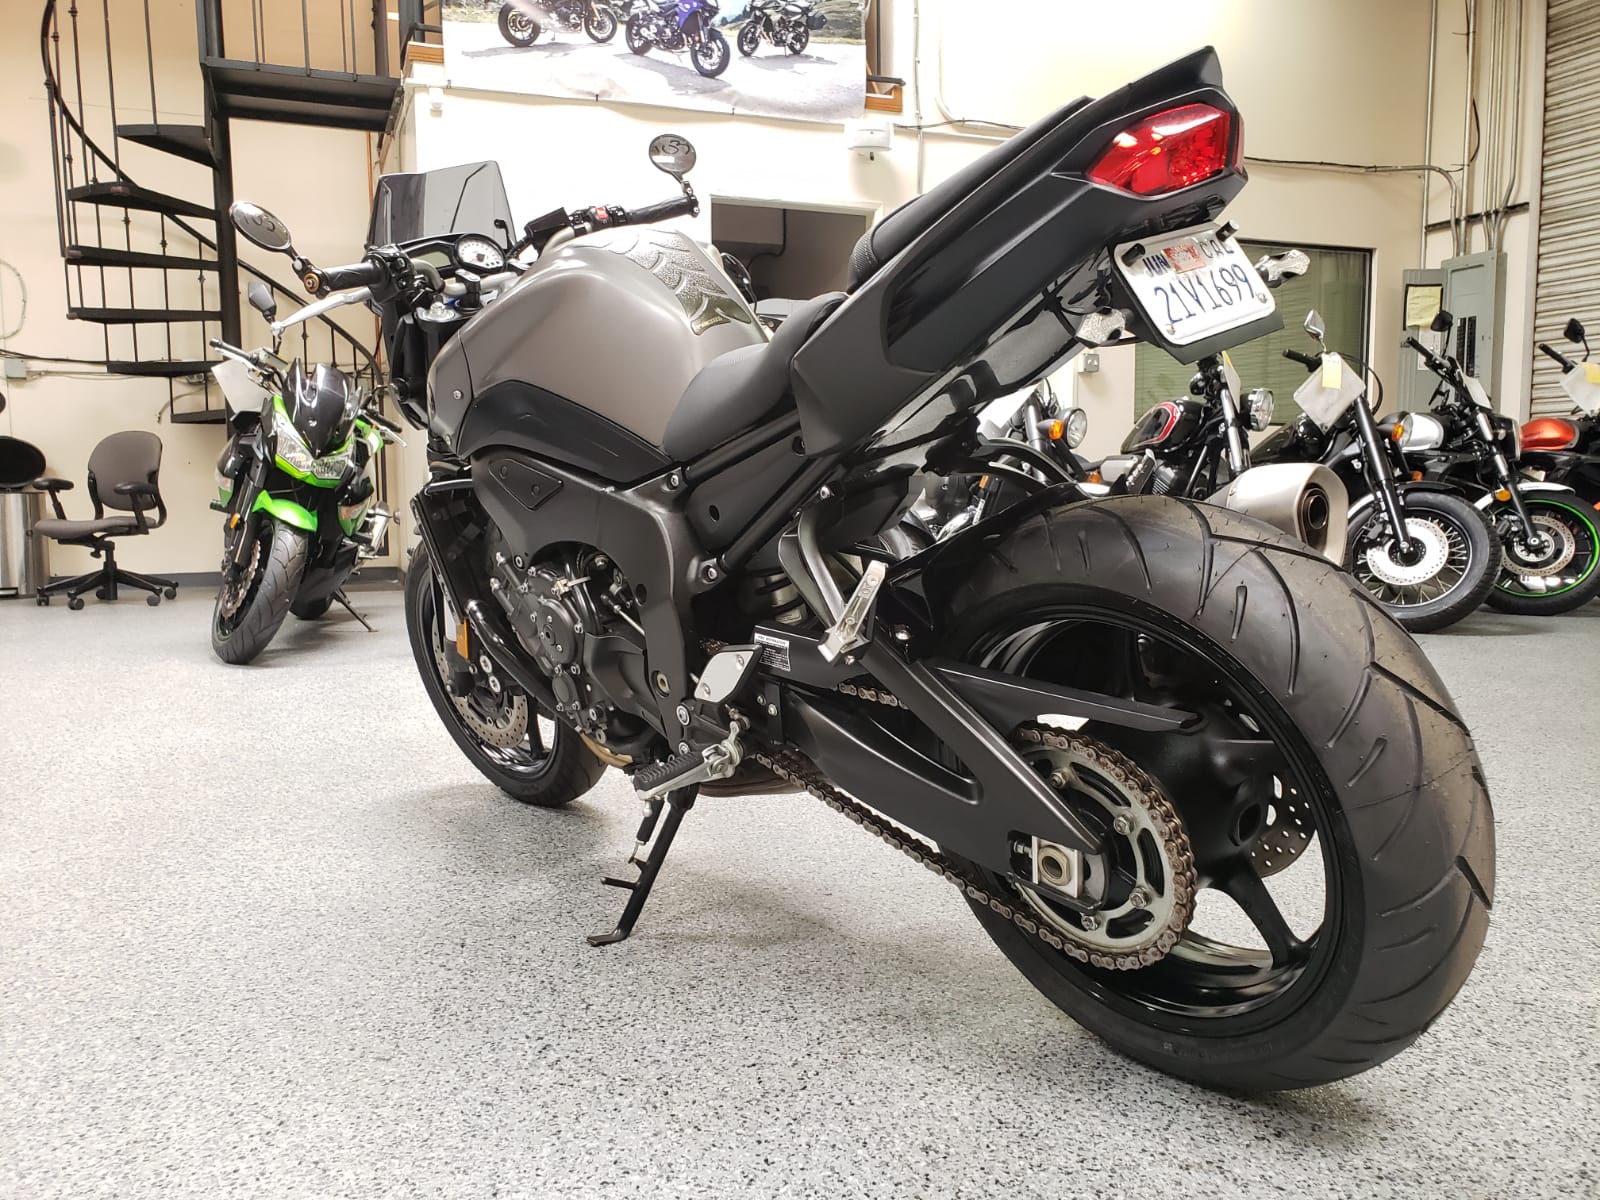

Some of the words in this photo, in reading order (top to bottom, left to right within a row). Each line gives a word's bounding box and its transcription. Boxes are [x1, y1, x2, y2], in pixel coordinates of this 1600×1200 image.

[1199, 239, 1234, 258] CAL
[1142, 253, 1170, 276] JUN
[1154, 264, 1255, 323] 21V1699
